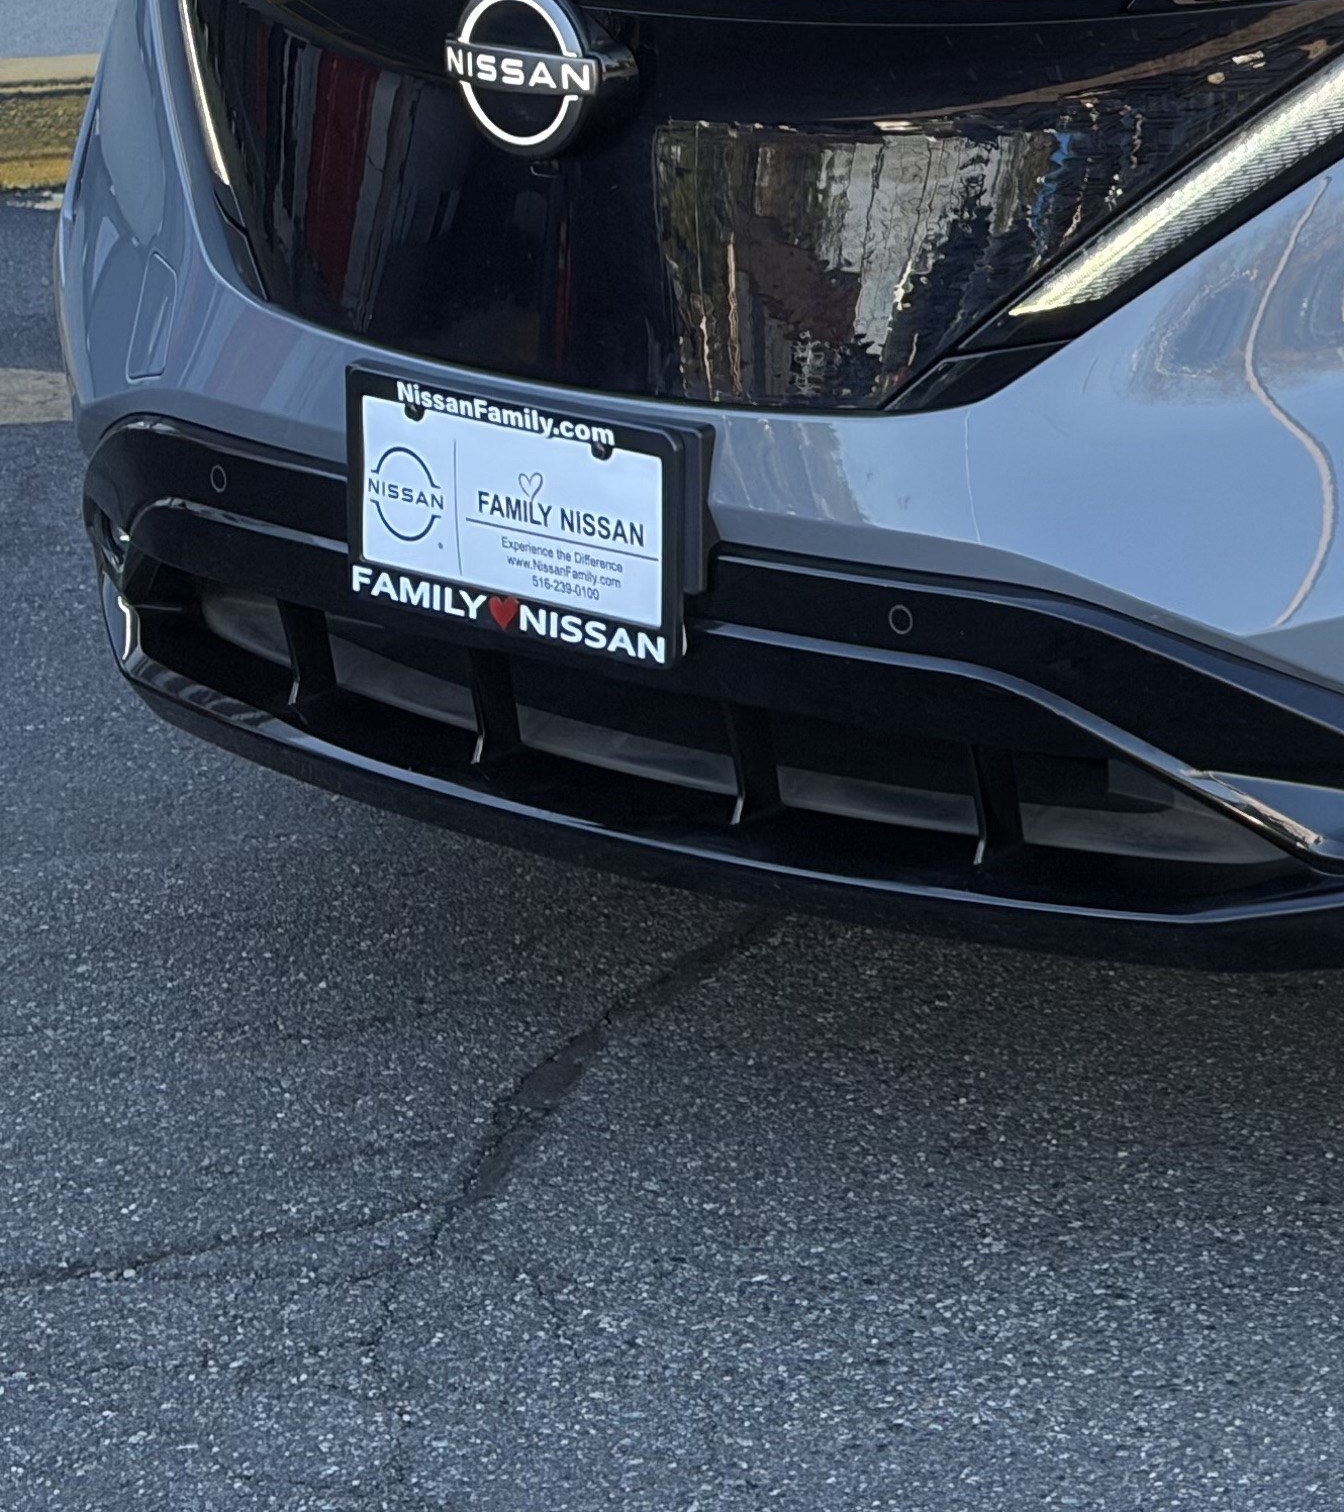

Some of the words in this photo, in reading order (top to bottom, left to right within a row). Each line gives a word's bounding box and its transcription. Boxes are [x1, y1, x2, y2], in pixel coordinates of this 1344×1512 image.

[445, 45, 591, 92] NISSAN
[396, 382, 615, 444] NissanFamily.com
[368, 477, 445, 511] NISSAN
[477, 489, 553, 528] FAMILY
[559, 506, 645, 548] NISSAN
[501, 536, 554, 558] Experience
[556, 548, 572, 563] the
[574, 551, 623, 573] Difference
[506, 555, 622, 589] www.NissanFamily.com
[531, 574, 600, 601] 516-239-0100
[351, 565, 488, 620] FAMILY
[518, 605, 666, 665] NISSAN
